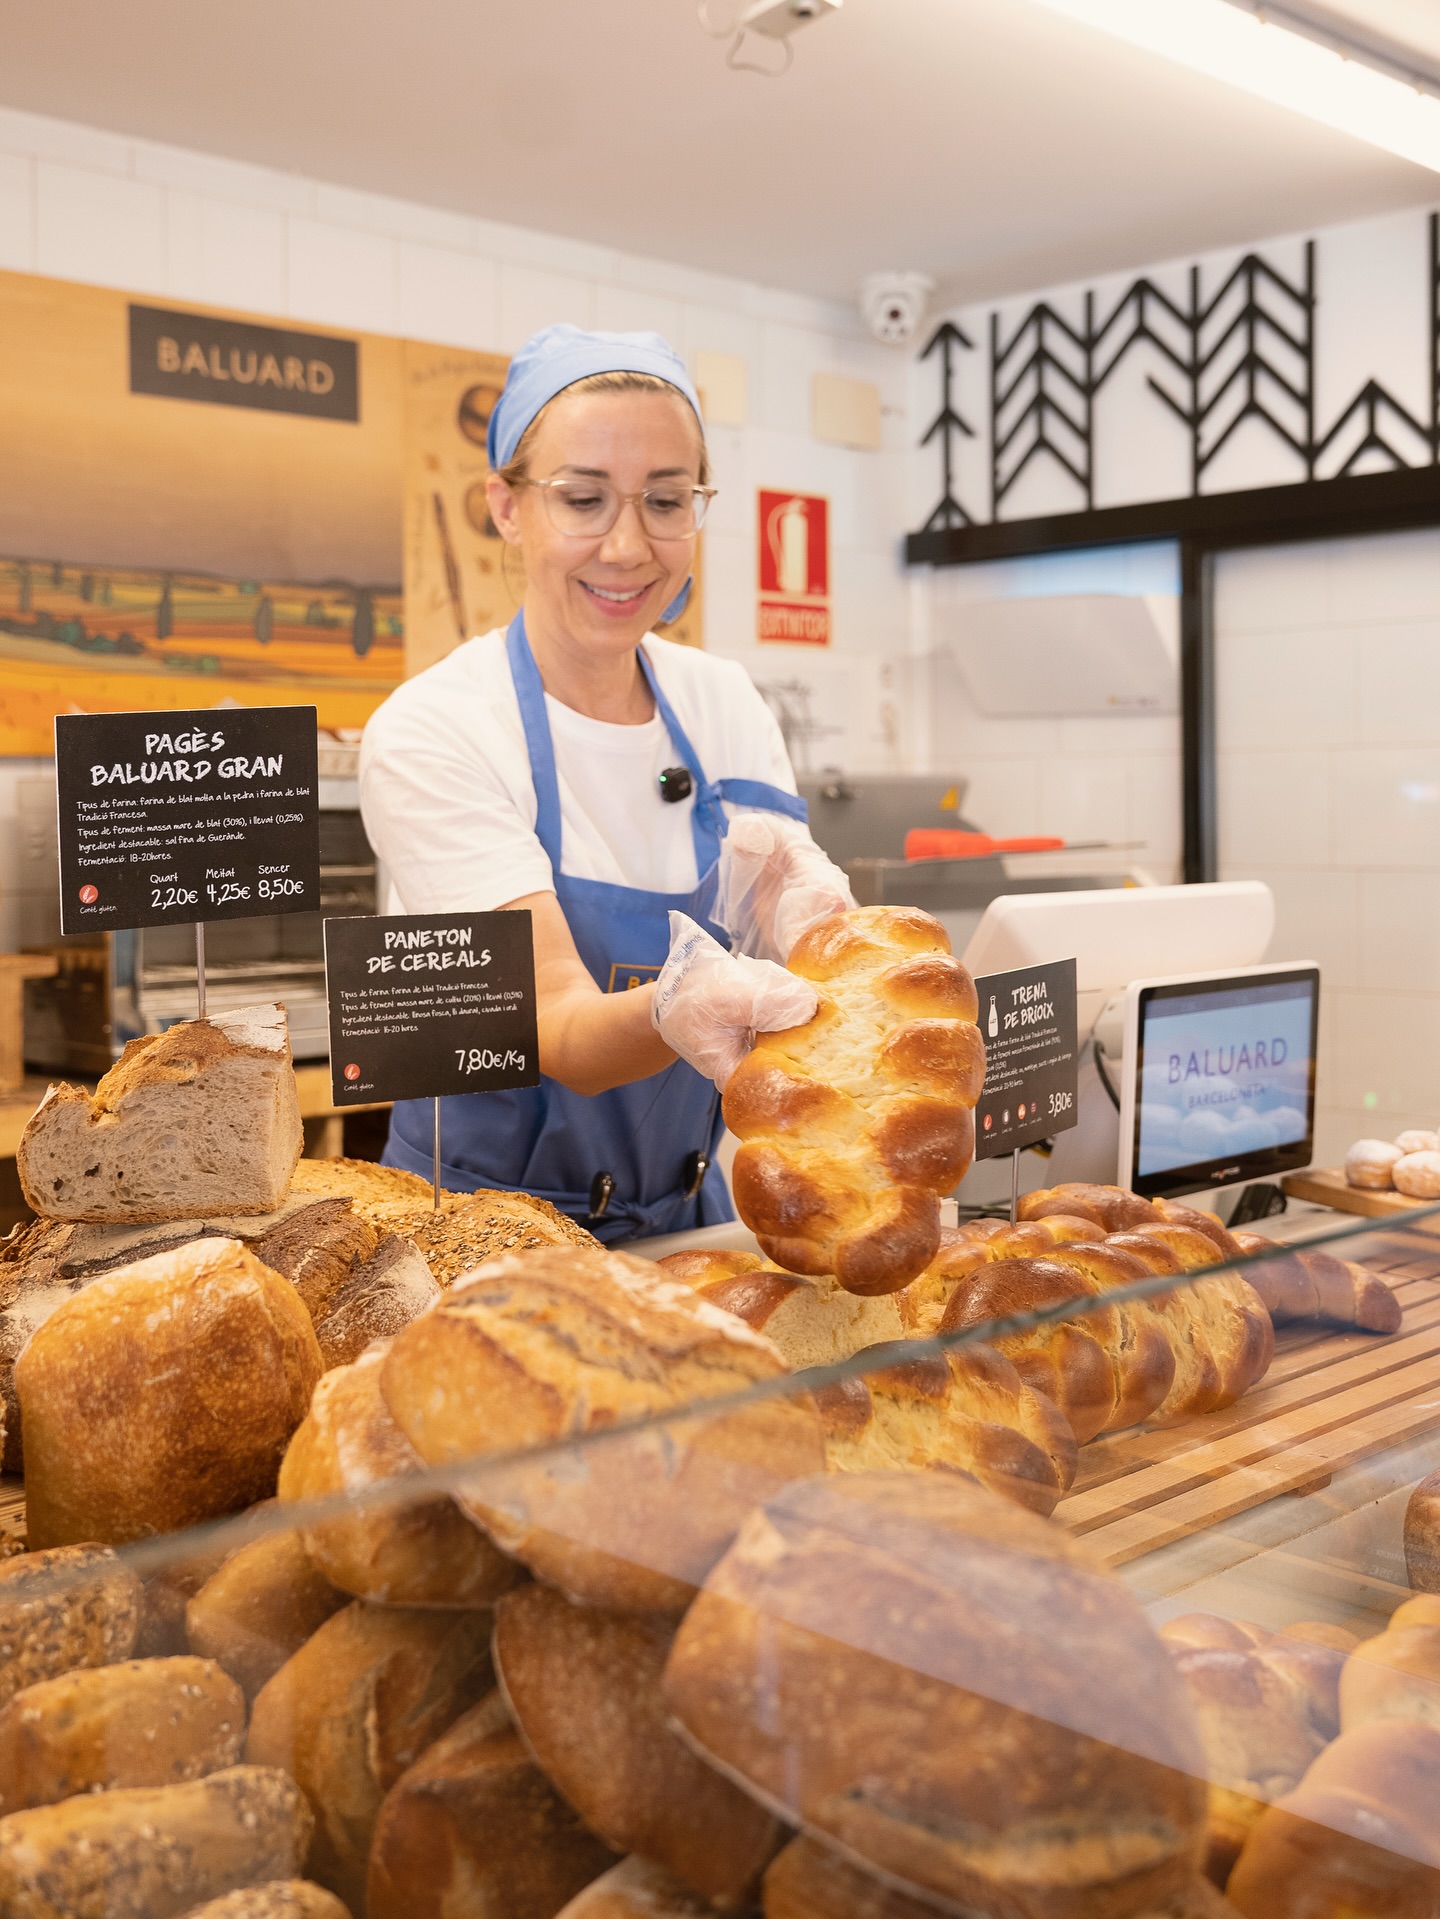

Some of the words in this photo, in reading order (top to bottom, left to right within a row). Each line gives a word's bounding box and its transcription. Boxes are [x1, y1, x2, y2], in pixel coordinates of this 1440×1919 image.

[157, 335, 335, 395] BALUARD
[145, 727, 225, 755] PAGÈS
[90, 761, 211, 786] BALUARD
[218, 755, 283, 779] GRAN
[76, 801, 98, 812] Tipus
[100, 800, 110, 808] de
[112, 799, 138, 807] farina:
[140, 797, 164, 805] farina
[167, 796, 176, 804] de
[179, 794, 192, 803] blat
[224, 792, 231, 800] la
[232, 791, 254, 802] pedra
[260, 789, 283, 798] farina
[285, 788, 295, 796] de
[296, 787, 310, 796] blat
[77, 812, 108, 822] Tradició
[77, 829, 99, 839] Tipus
[101, 827, 111, 835] de
[113, 825, 145, 834] ferment:
[147, 824, 172, 832] massa
[173, 822, 192, 830] mare
[195, 820, 205, 829] de
[207, 819, 221, 828] blat
[253, 816, 274, 824] llevat
[78, 841, 116, 854] Ingredient
[118, 838, 163, 849] destacable:
[165, 836, 177, 845] sal
[178, 835, 194, 844] fina
[196, 834, 206, 843] de
[150, 872, 178, 884] Quart
[206, 868, 236, 879] Meitat
[258, 864, 290, 875] Sencer
[151, 888, 198, 910] 2,20€
[207, 883, 250, 906] 4,25€
[258, 879, 305, 900] 8,50€
[384, 927, 472, 950] PANETON
[366, 955, 396, 974] DE
[401, 949, 492, 971] CEREALS
[340, 991, 358, 1000] Tipus
[1011, 981, 1047, 1006] TRENA
[341, 1003, 358, 1013] Tipus
[360, 1002, 368, 1010] de
[342, 1015, 372, 1026] Ingredient
[1003, 1011, 1019, 1030] DE
[455, 1049, 526, 1075] 7,80€/Kg
[1168, 1037, 1288, 1084] BALUARD
[1048, 1092, 1073, 1117] 3,80€
